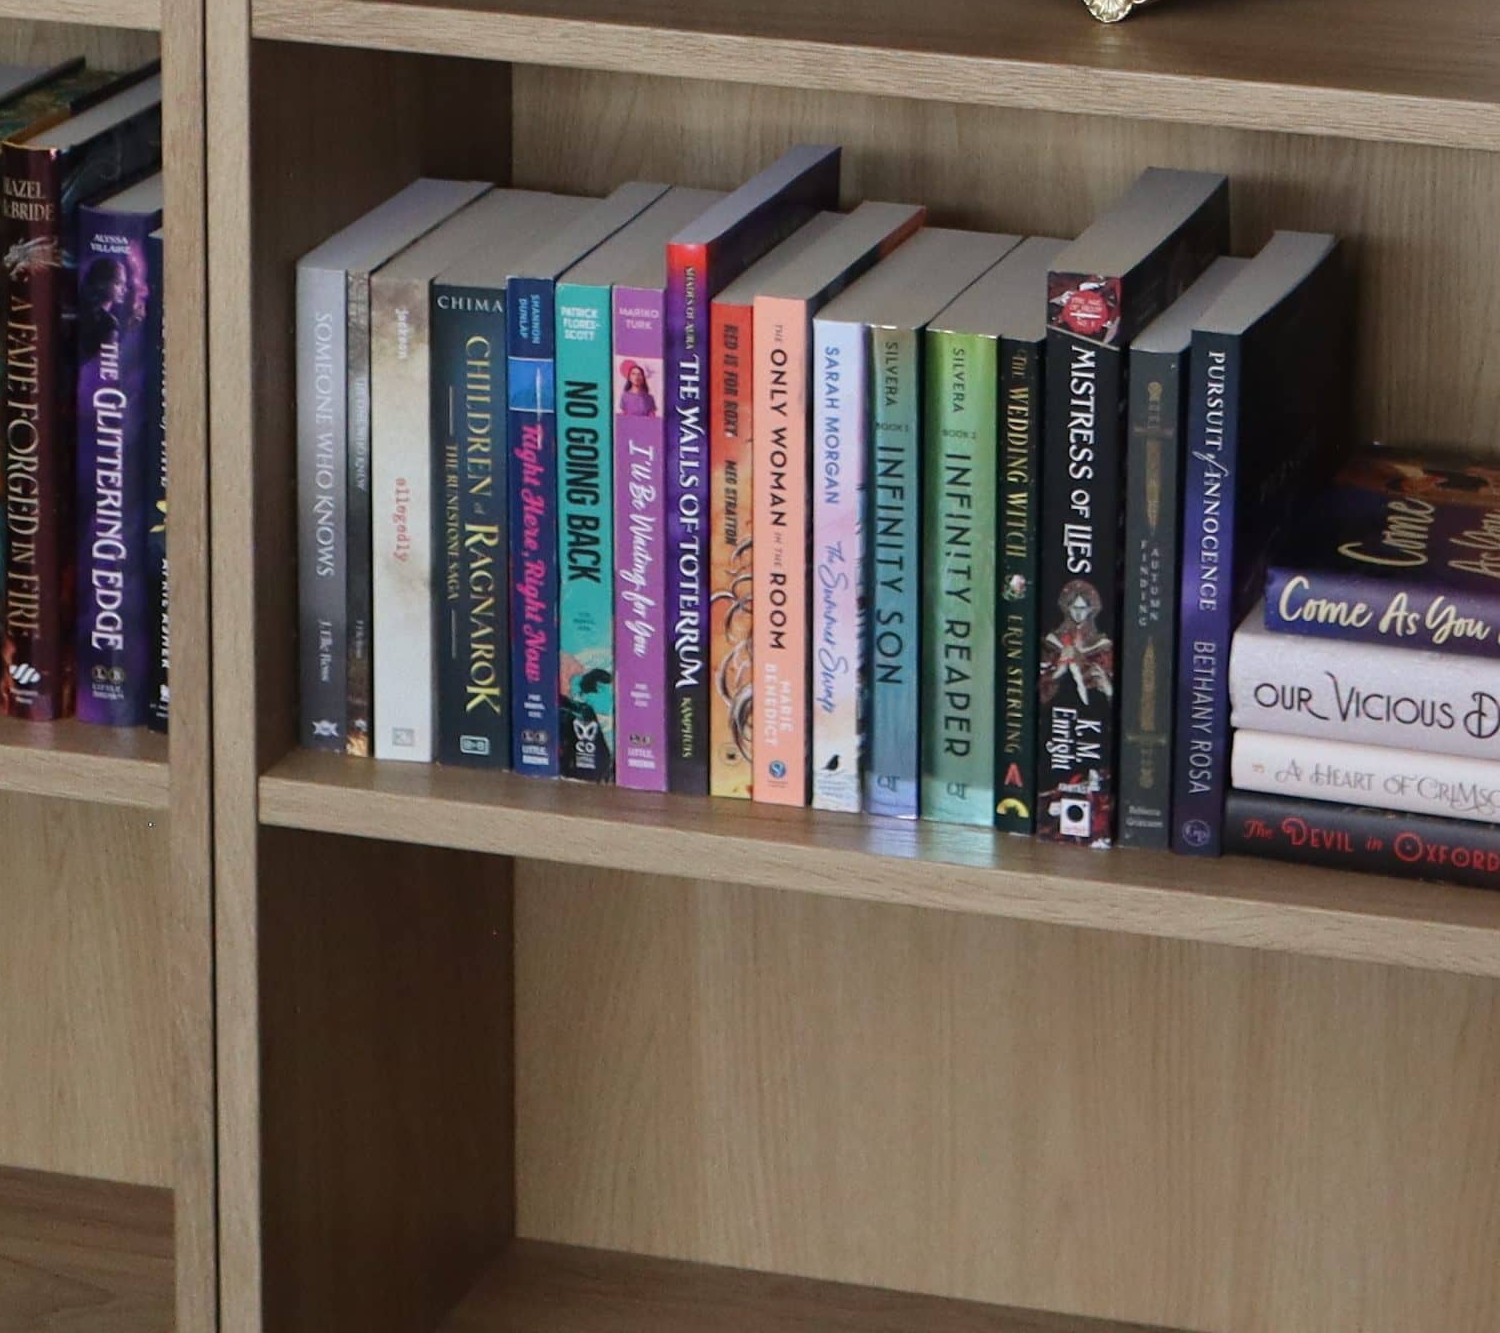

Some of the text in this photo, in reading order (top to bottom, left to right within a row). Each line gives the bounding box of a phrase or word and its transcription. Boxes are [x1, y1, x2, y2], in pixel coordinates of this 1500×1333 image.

[565, 379, 601, 586] NO GOING BACK
[877, 445, 905, 688] INFINITY SON
[1256, 683, 1330, 721] OUR
[1325, 671, 1454, 730] VICIOUS
